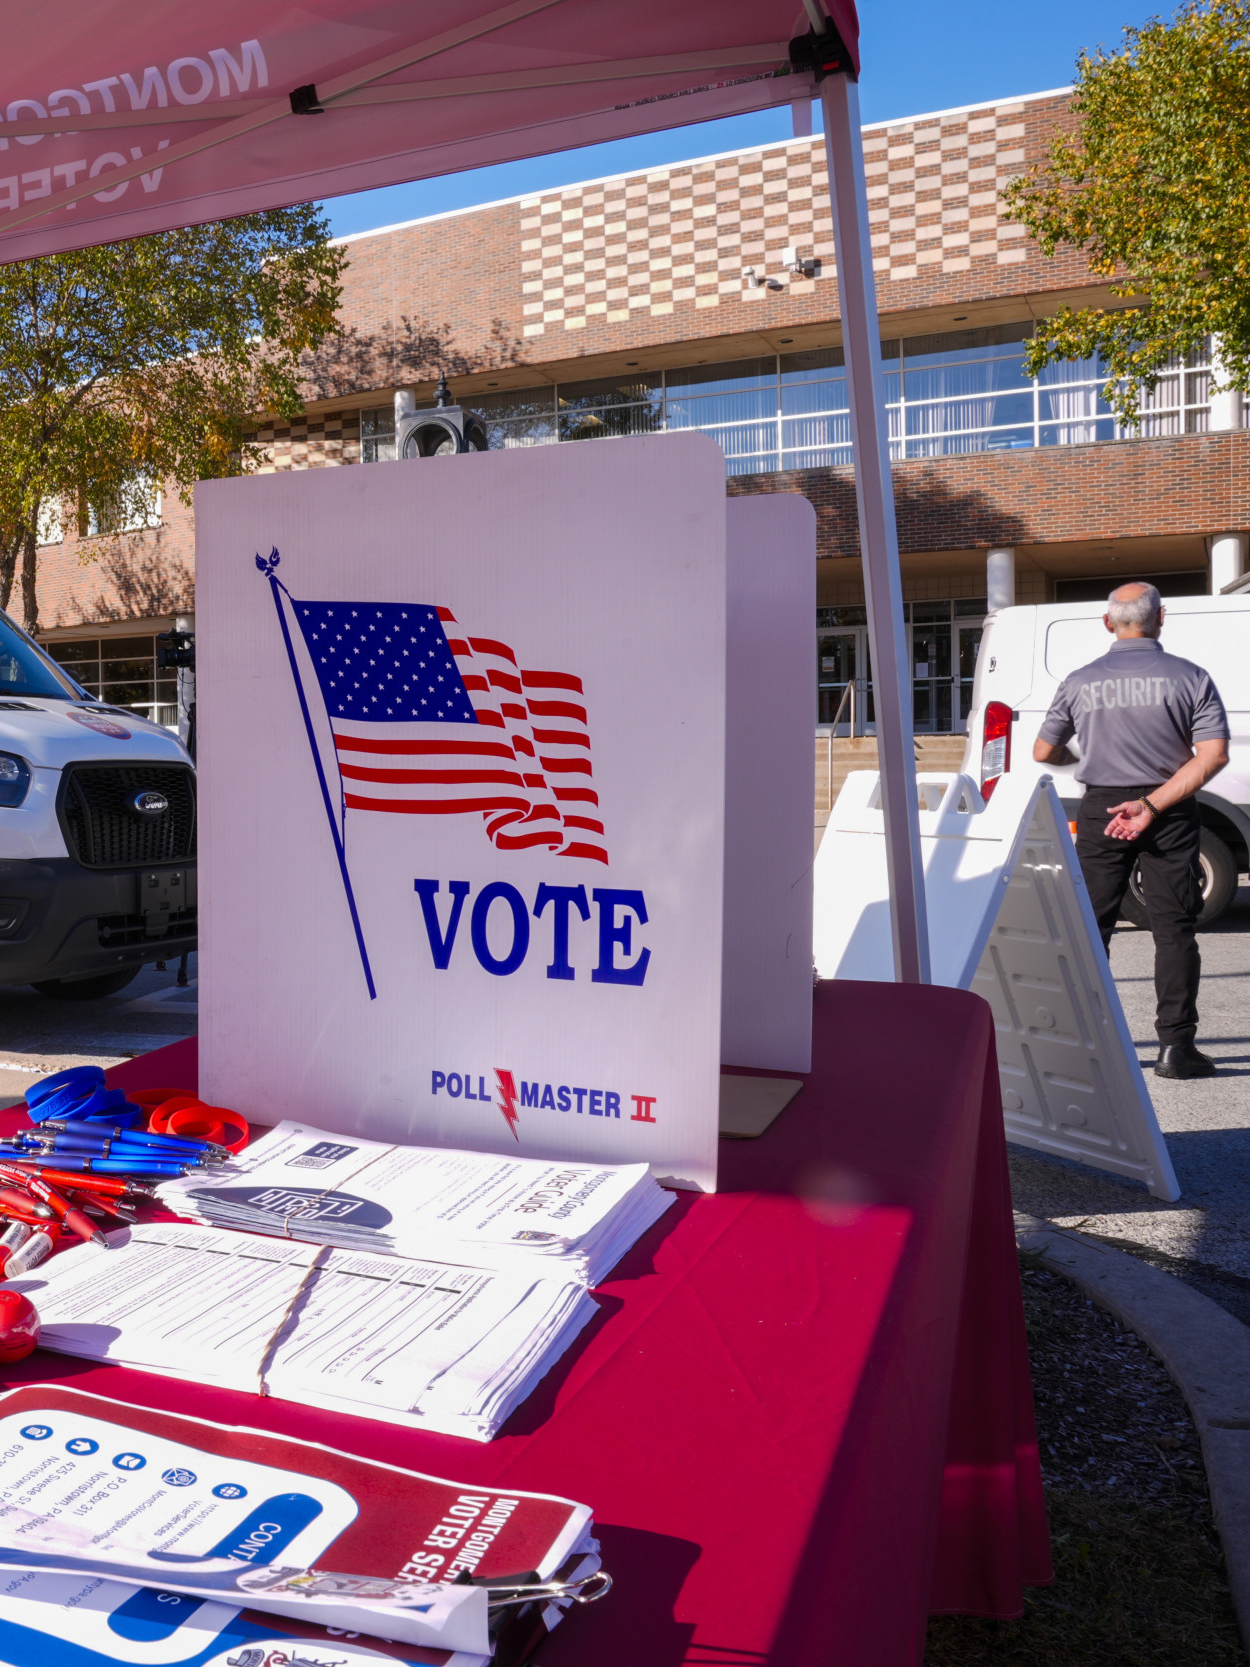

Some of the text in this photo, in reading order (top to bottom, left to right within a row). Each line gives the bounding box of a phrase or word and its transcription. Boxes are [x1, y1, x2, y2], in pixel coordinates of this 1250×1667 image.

[1079, 677, 1178, 713] SECURITY
[414, 878, 652, 987] VOTE
[431, 1070, 657, 1124] POLL MASTER II
[544, 1169, 590, 1189] Voter
[513, 1188, 563, 1214] Guide
[547, 1195, 575, 1219] County
[8, 1455, 61, 1491] Norristown,
[26, 1475, 61, 1497] Swede
[58, 1461, 77, 1476] 425
[58, 1471, 109, 1507] Norristown,
[73, 1476, 127, 1517] P.O. Box 311
[154, 1500, 201, 1537] VoterServices
[423, 1495, 490, 1549] VOTER
